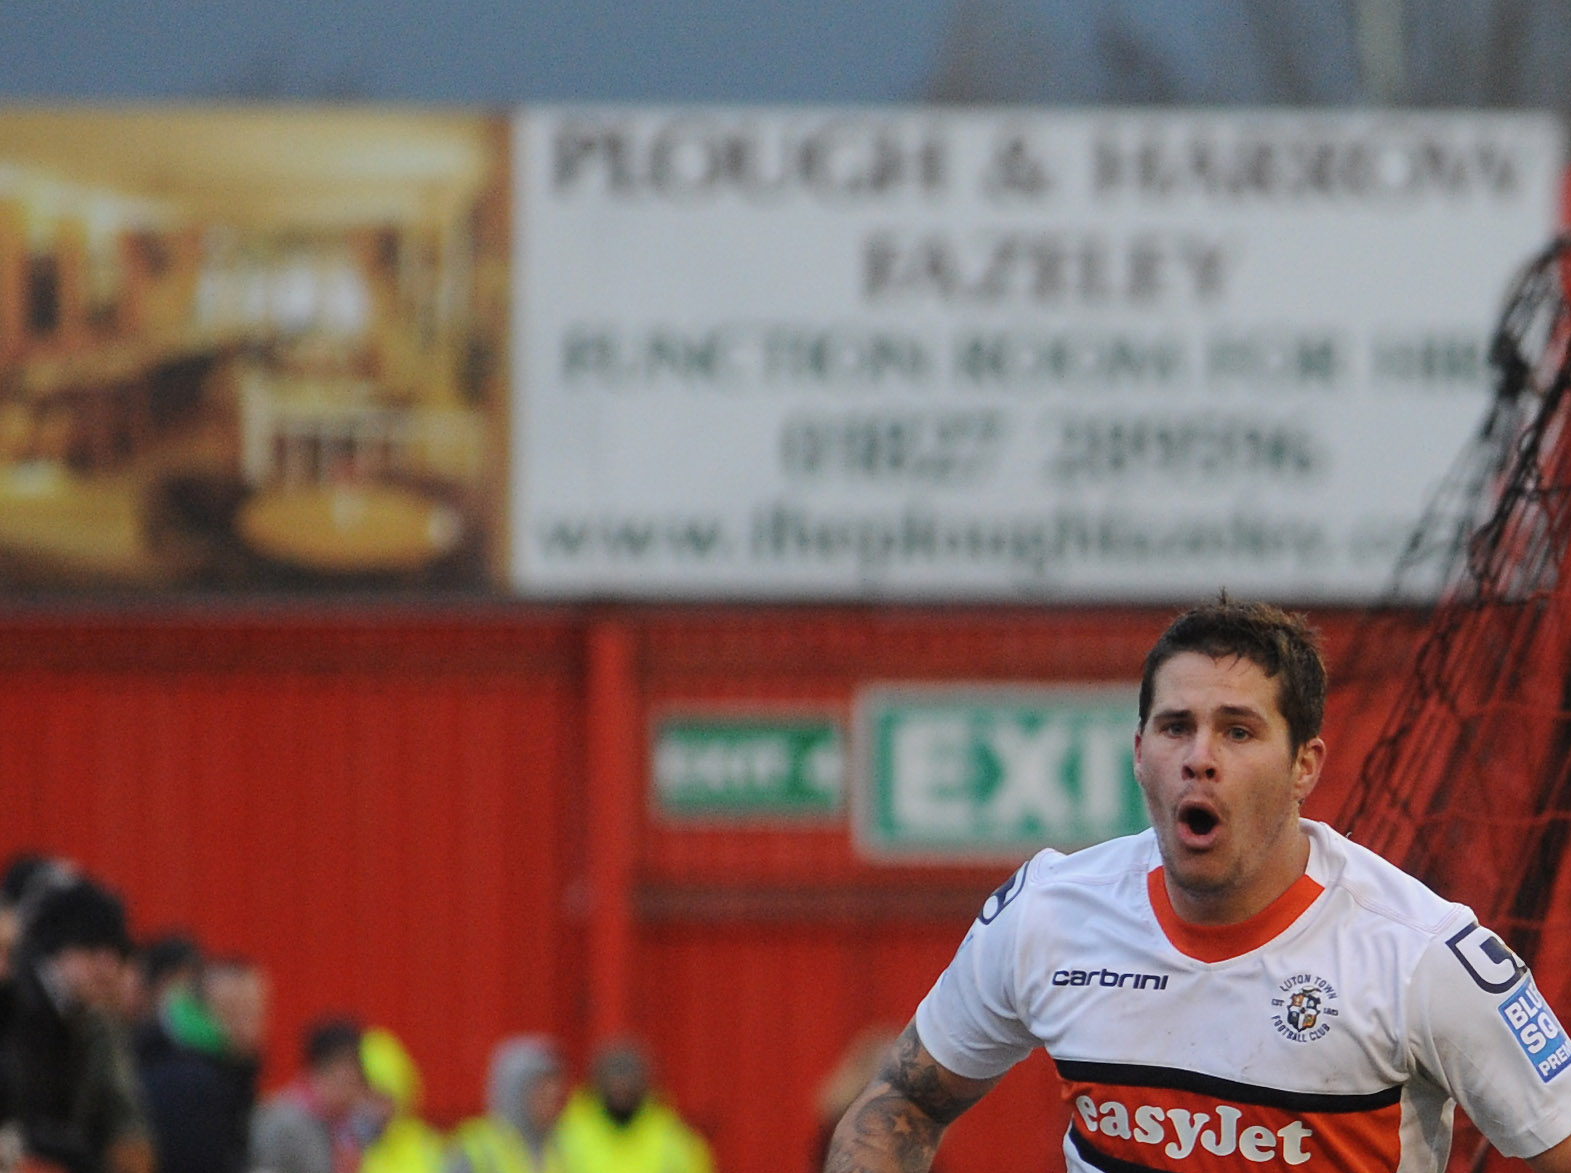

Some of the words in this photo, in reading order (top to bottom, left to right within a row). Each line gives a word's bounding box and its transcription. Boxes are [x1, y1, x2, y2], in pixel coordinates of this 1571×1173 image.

[548, 128, 948, 202] PLOUGH
[980, 128, 1055, 202] &
[1092, 128, 1530, 202] HARROW
[858, 230, 1240, 306] FAZELEY
[560, 324, 932, 390] FUNCTION
[950, 324, 1186, 390] ROOM
[892, 715, 1134, 836] EXI
[1051, 968, 1169, 990] carbrini
[1279, 973, 1311, 992] LUTON
[1314, 975, 1338, 1000] TOWN
[1270, 1014, 1308, 1043] FOOTBALL
[1309, 1022, 1330, 1041] CLUB
[1075, 1094, 1313, 1166] easyJet
